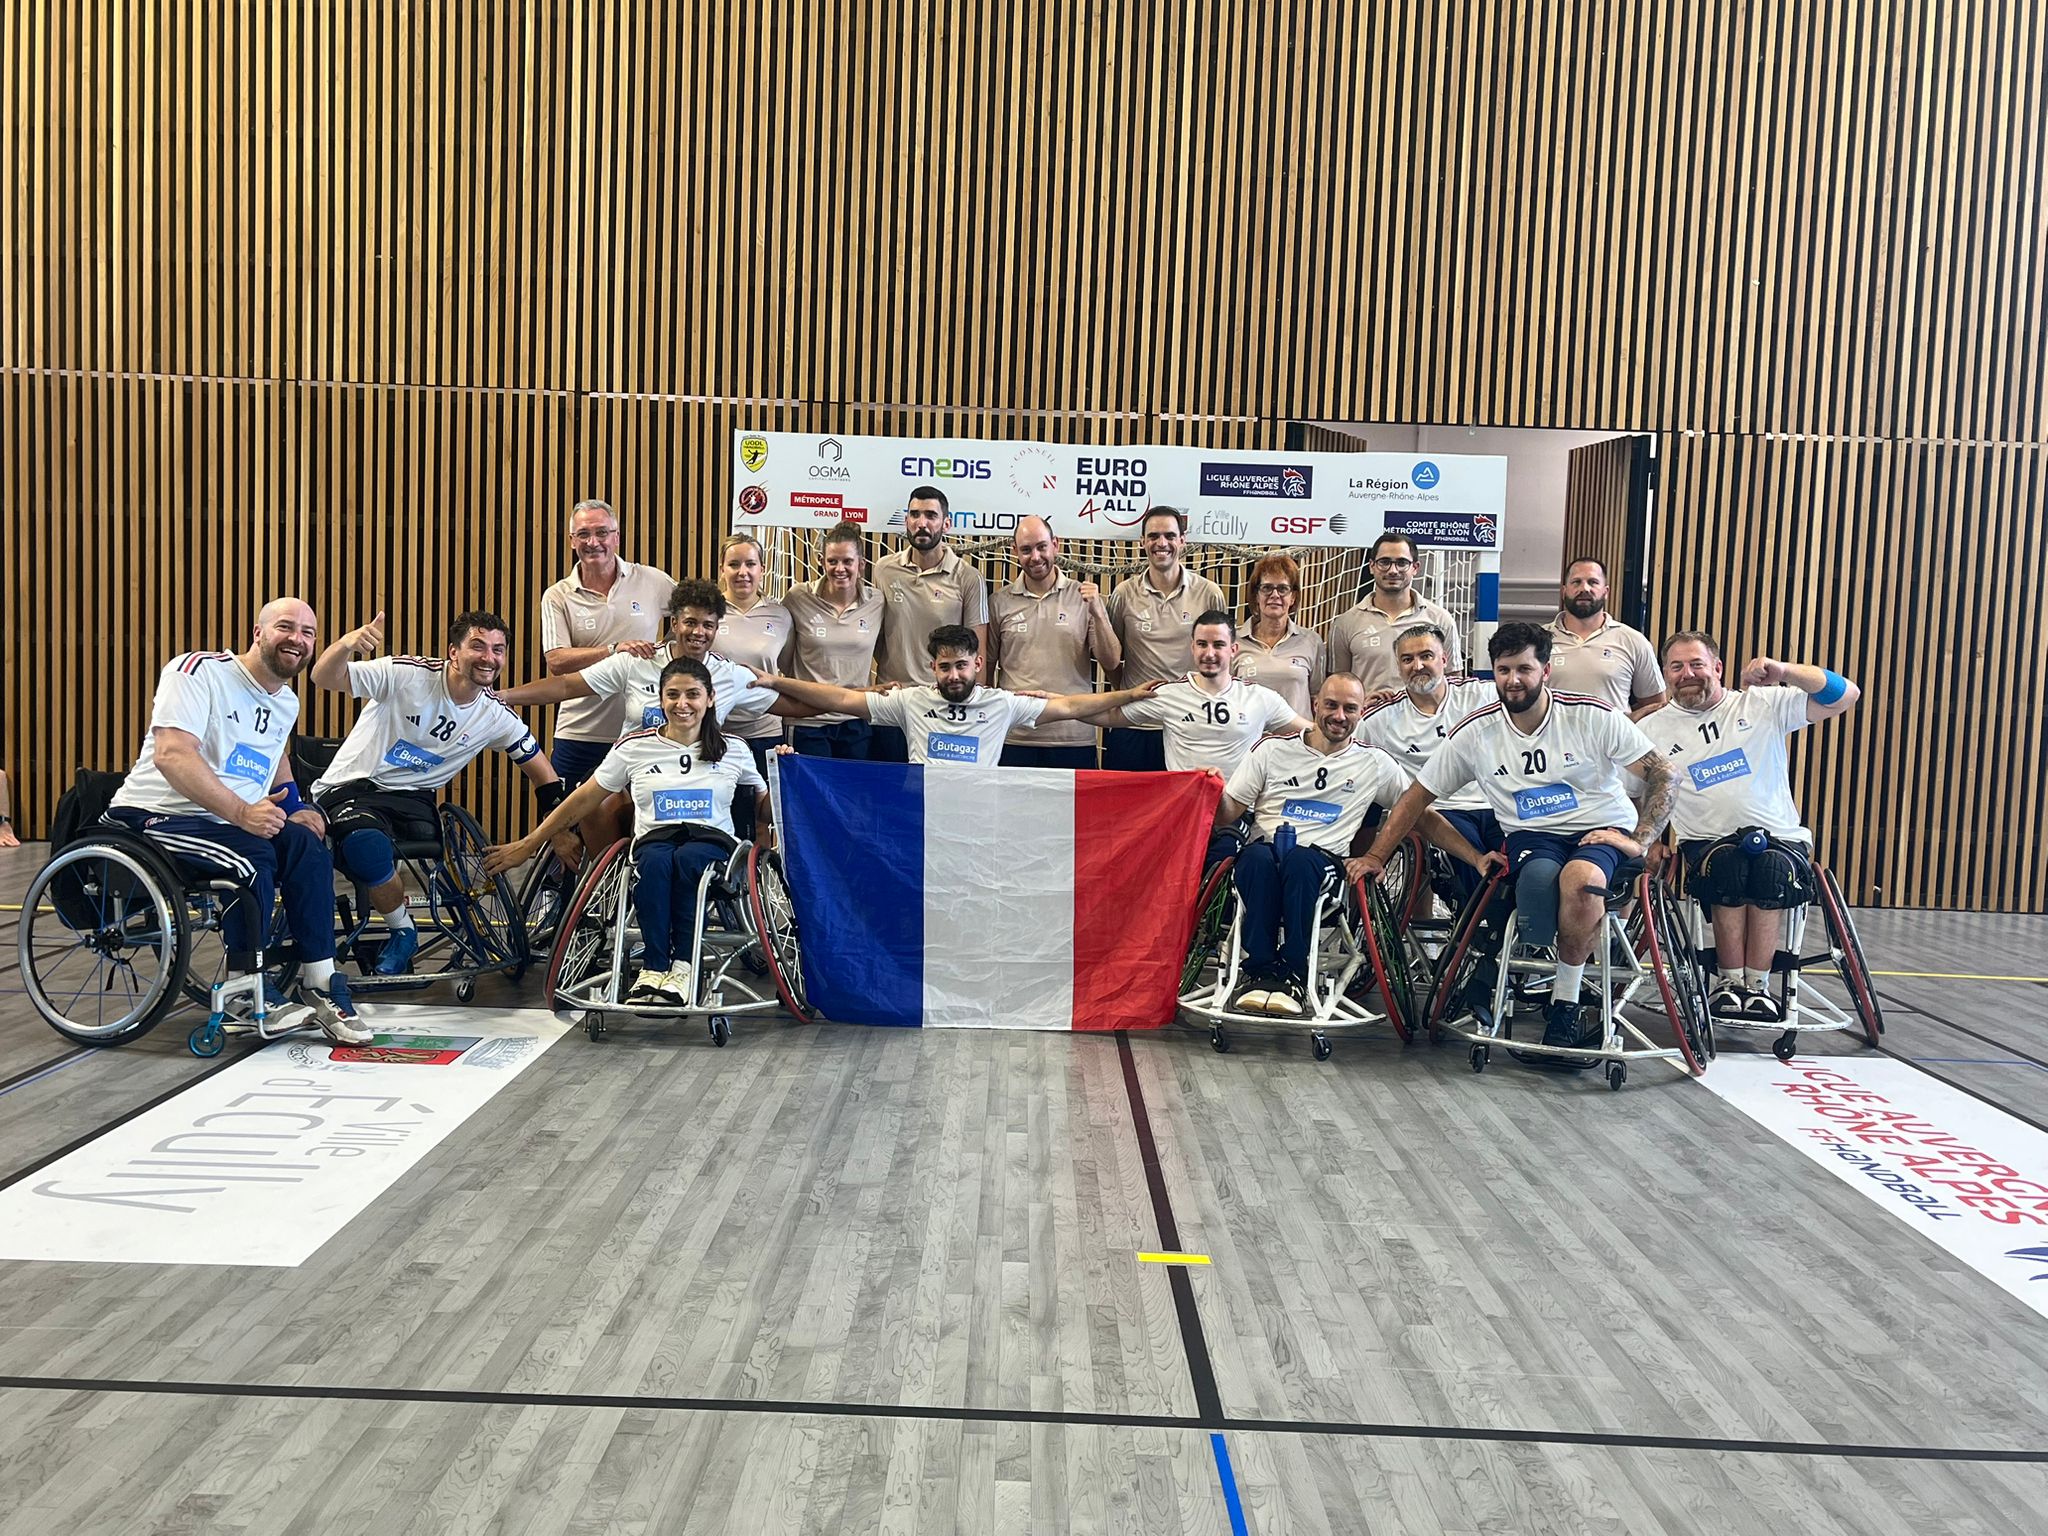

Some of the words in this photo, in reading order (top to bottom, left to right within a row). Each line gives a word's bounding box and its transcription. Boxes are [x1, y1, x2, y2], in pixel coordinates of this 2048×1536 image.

[809, 465, 851, 478] OGMA
[1077, 457, 1147, 476] EURO
[1076, 478, 1147, 497] HAND
[1206, 474, 1231, 482] LIGUE
[1232, 475, 1279, 484] AUVERGNE
[1349, 478, 1363, 488] La
[1366, 478, 1409, 491] Région
[793, 495, 840, 505] MÉTROPOLE
[813, 510, 839, 518] GRAND
[845, 511, 864, 519] LYON
[1078, 498, 1101, 524] 4
[1103, 499, 1136, 512] ALL
[1214, 510, 1230, 519] Ville
[1271, 516, 1326, 534] GSF
[254, 706, 272, 735] 13
[947, 704, 967, 721] 33
[1201, 701, 1230, 725] 16
[429, 715, 457, 742] 28
[1698, 721, 1720, 745] 11
[936, 741, 976, 755] Butagaz
[680, 754, 692, 775] 9
[1521, 749, 1547, 775] 20
[1701, 758, 1746, 779] Butagaz
[1314, 767, 1328, 791] 8
[665, 799, 710, 811] Butagaz
[1526, 792, 1573, 809] Butagaz
[1779, 1059, 1891, 1104] LIGUE
[305, 1121, 423, 1157] Ville
[1771, 1082, 1914, 1146] RHÔNE
[1882, 1151, 2048, 1226] ALPES
